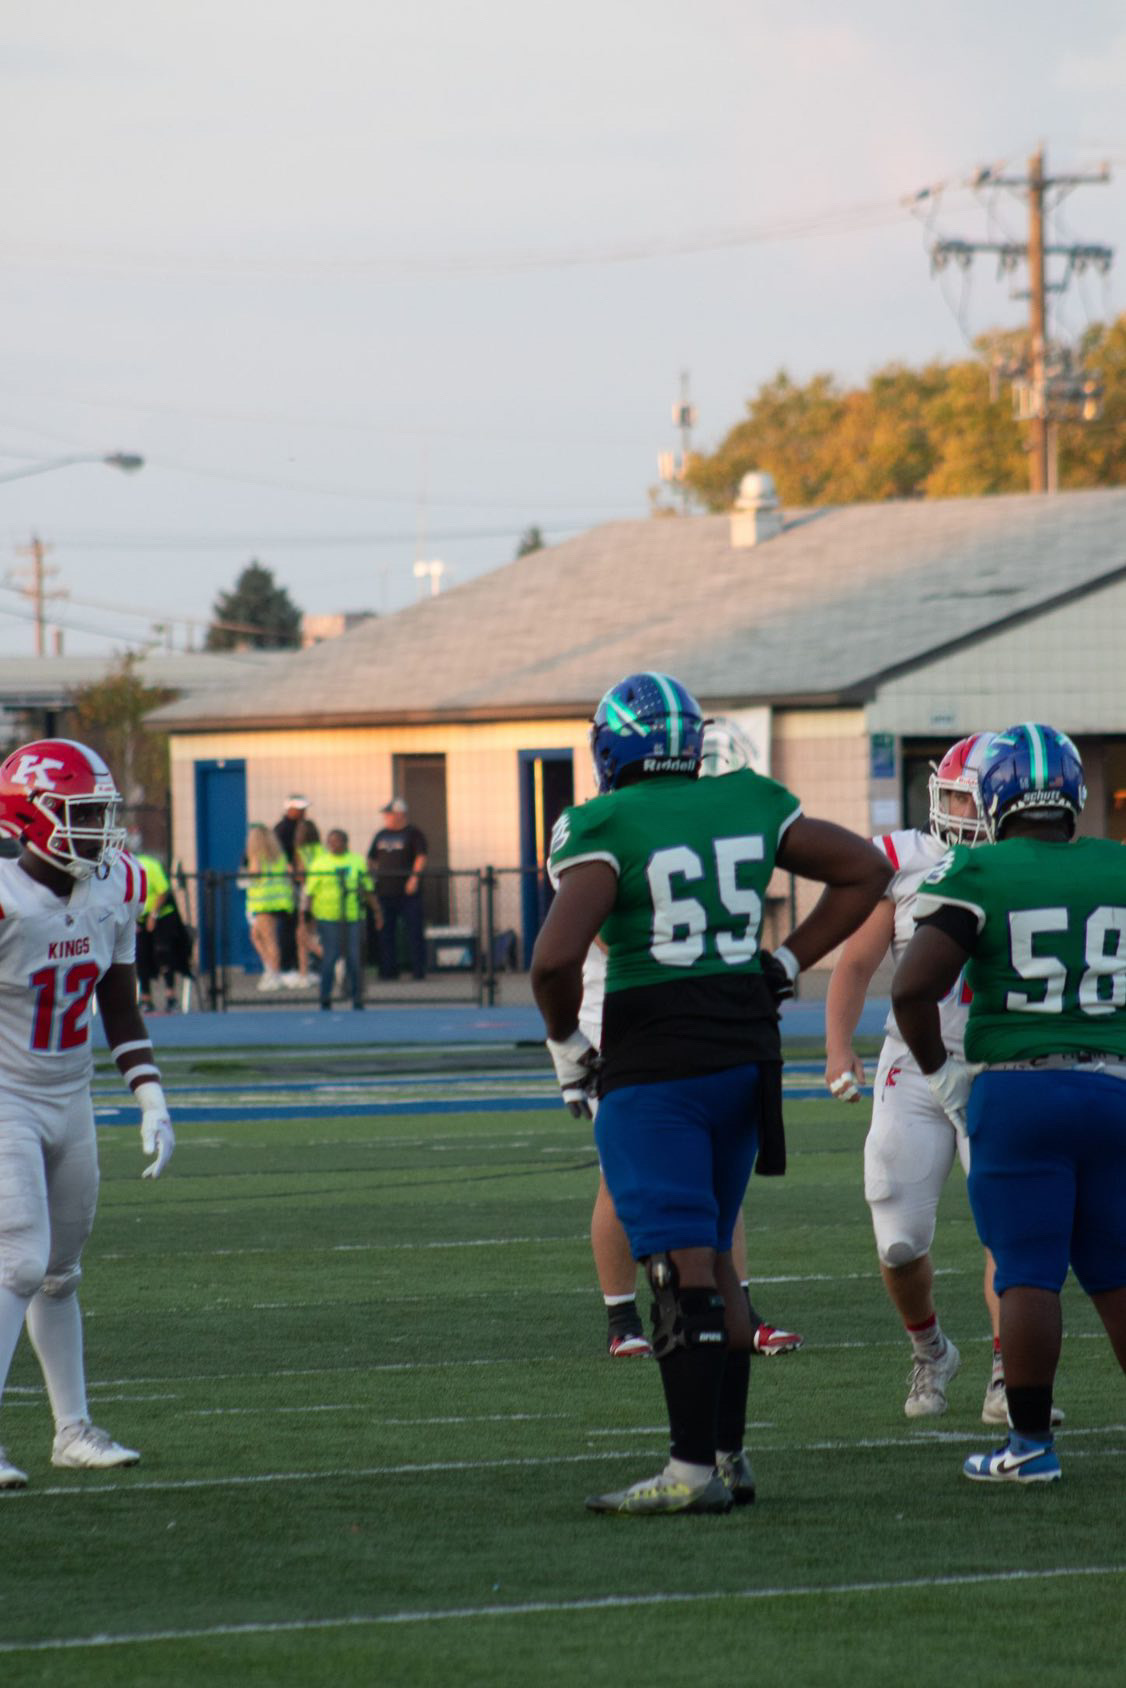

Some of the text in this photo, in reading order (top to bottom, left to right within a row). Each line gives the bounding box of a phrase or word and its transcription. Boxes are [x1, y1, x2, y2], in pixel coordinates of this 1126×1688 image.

[10, 754, 65, 791] K
[643, 758, 696, 772] Riddell
[646, 831, 766, 967] 65
[48, 936, 90, 960] KINGS
[1006, 905, 1126, 1016] 58
[28, 959, 101, 1053] 12
